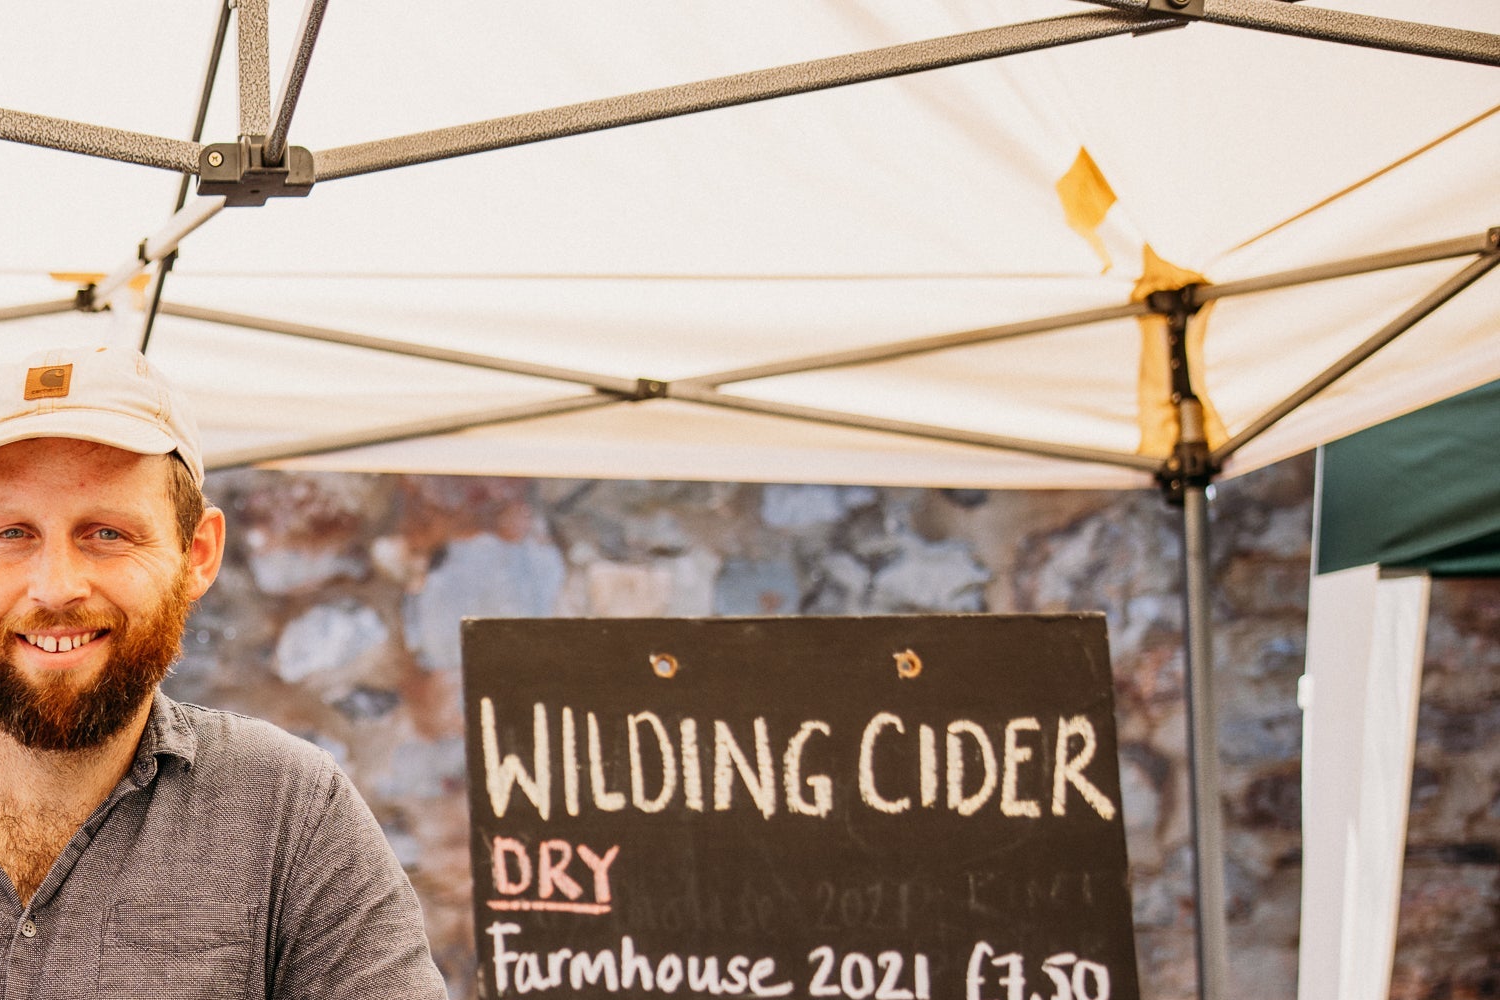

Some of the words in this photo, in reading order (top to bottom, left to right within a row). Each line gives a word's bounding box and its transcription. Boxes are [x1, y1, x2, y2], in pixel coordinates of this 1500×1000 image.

[481, 697, 833, 819] WILDING
[859, 712, 1117, 819] CIDER
[491, 836, 620, 903] DRY
[487, 921, 795, 998] Farmhouse
